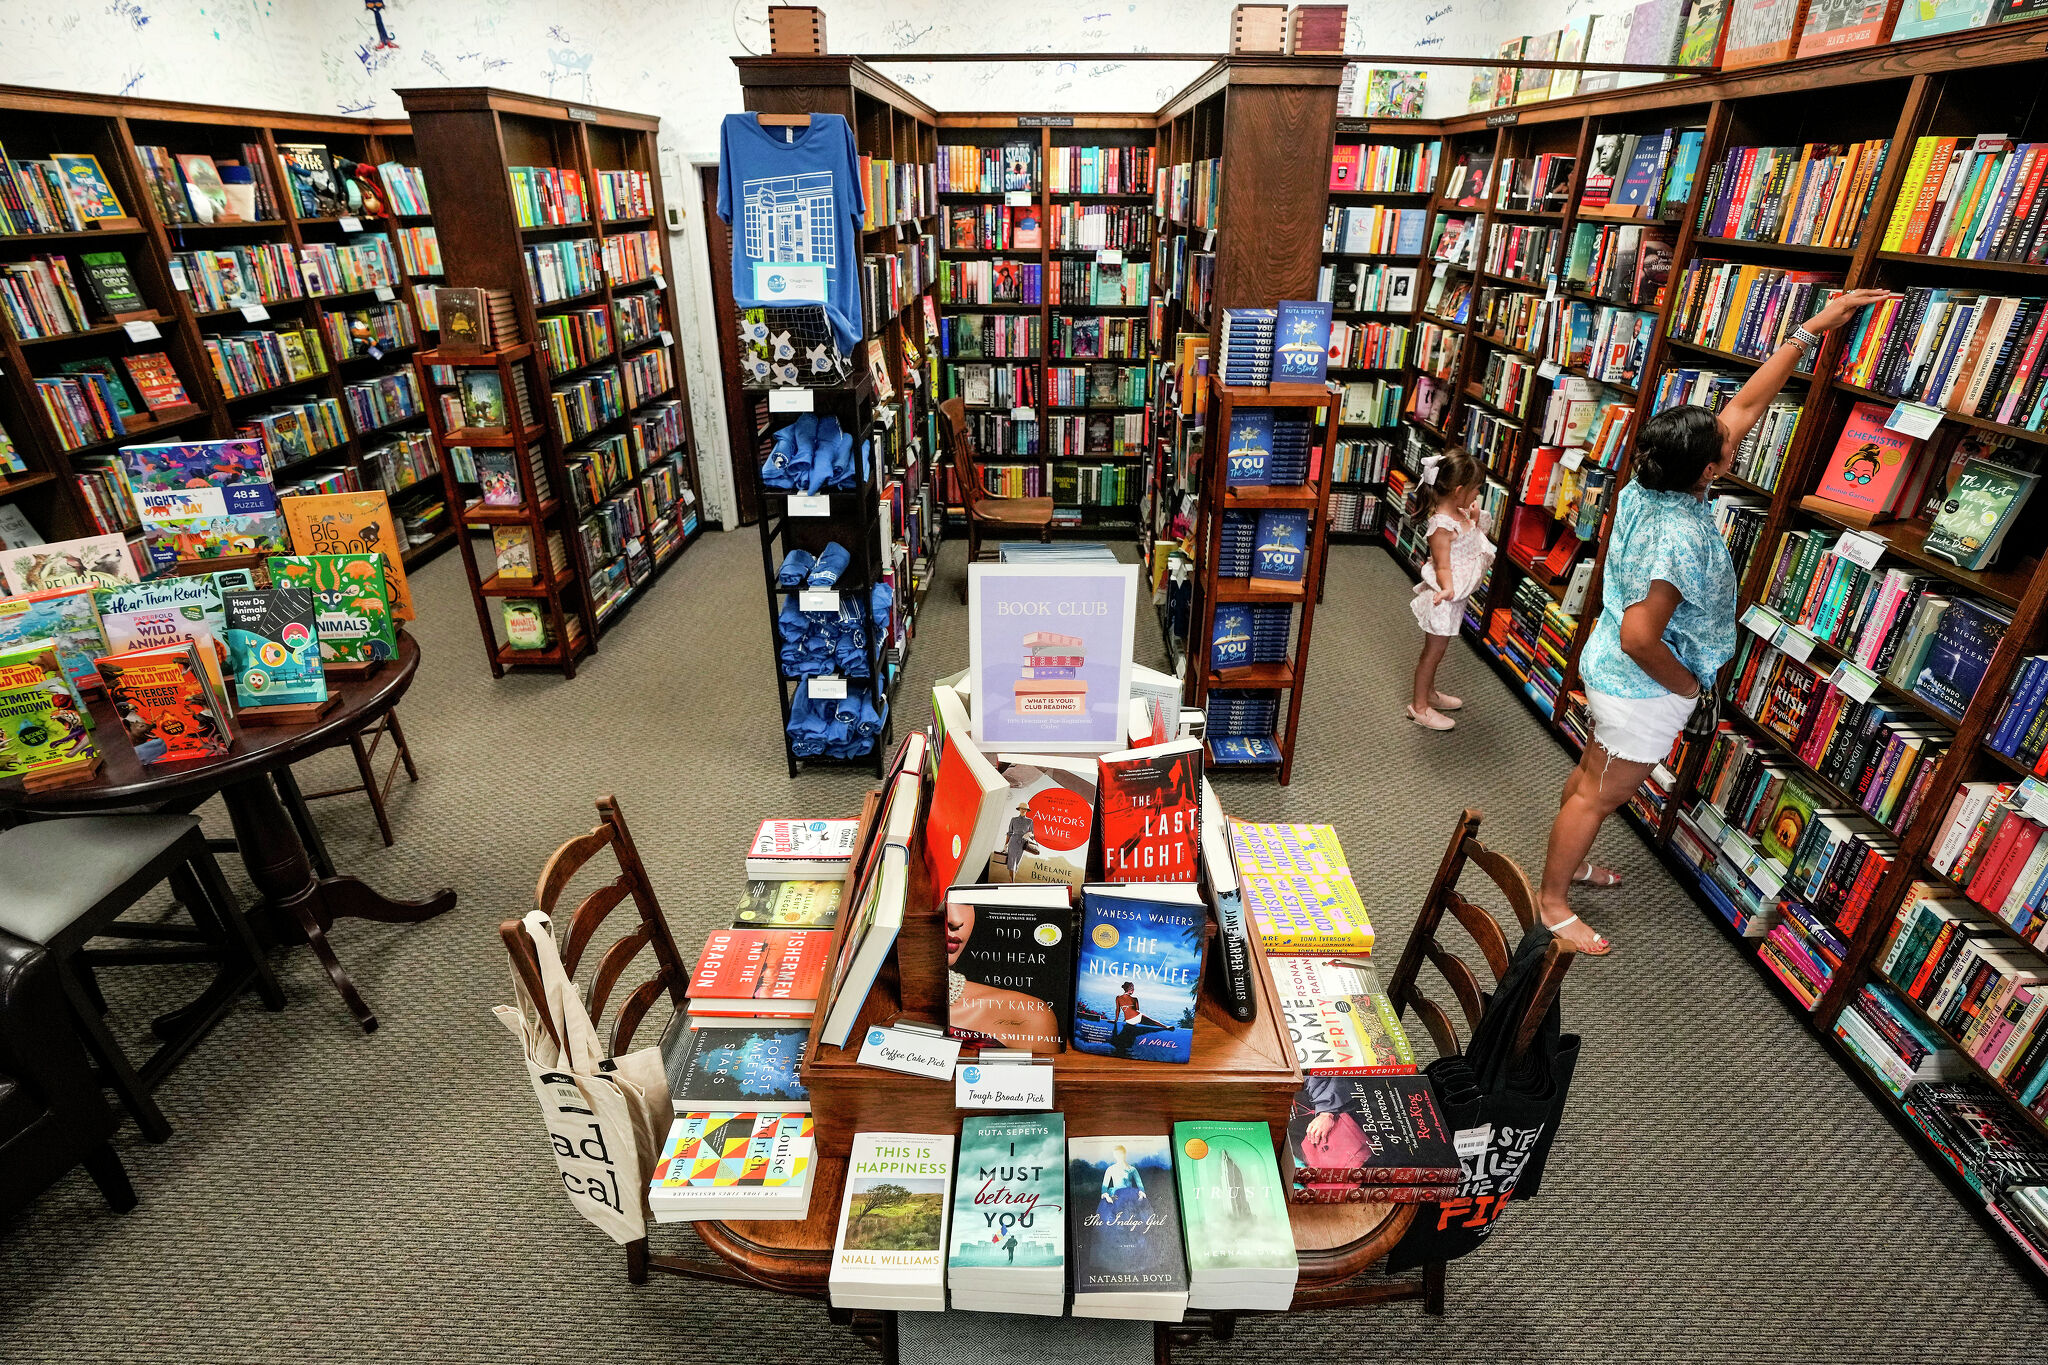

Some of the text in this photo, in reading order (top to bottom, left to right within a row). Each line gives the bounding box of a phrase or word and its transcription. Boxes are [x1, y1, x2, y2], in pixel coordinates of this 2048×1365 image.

[1826, 30, 1871, 46] HAVE POWER
[1922, 143, 1952, 212] WHEN IN ROME
[92, 268, 128, 279] RADIUM
[102, 276, 128, 288] GIRLS
[130, 360, 167, 370] WHO'S
[1284, 354, 1318, 364] YOU
[137, 370, 158, 379] GOT
[1282, 364, 1318, 375] The Story
[141, 377, 174, 388] MAIL?
[1847, 430, 1906, 450] CHEMISTRY
[1976, 430, 2016, 450] HELLO
[1231, 458, 1264, 469] YOU
[233, 490, 248, 499] 48
[1825, 484, 1876, 504] Bonnie Garmus
[1960, 474, 2014, 497] The Last
[144, 494, 177, 507] NIGHT
[182, 503, 203, 515] DAY
[234, 500, 265, 509] PUZZLE
[1961, 489, 1995, 512] Thing
[310, 522, 339, 542] BIG
[1927, 533, 1951, 546] Laura
[110, 584, 210, 614] Hear Them Roar!
[232, 599, 252, 607] How
[996, 601, 1108, 616] BOOK CLUB
[133, 612, 173, 622] PAPERFOLD
[232, 606, 267, 614] Animals
[240, 614, 260, 622] See?
[137, 624, 176, 636] WILD
[316, 620, 368, 632] NIMALS
[1953, 626, 1982, 645] NIGHT
[1938, 632, 1990, 664] TRAVELERS
[120, 668, 183, 687] WOULD WIN?
[1784, 666, 1813, 694] FIRE
[134, 686, 179, 698] FIERCEST
[1921, 680, 1966, 711] LUCAS CORREA
[1930, 678, 1960, 698] ARMANDO
[0, 700, 52, 718] OWDOWN
[147, 696, 176, 708] FEUDS
[1774, 685, 1808, 718] RUSH
[1840, 730, 1853, 755] BOX
[1850, 741, 1864, 770] JUDAS
[1858, 766, 1874, 794] SPIDER
[1132, 795, 1151, 808] THE
[1032, 810, 1086, 828] AVIATOR'S
[1145, 808, 1196, 838] LAST
[774, 822, 792, 853] MURDER
[1044, 824, 1071, 840] WIFE
[1106, 842, 1184, 869] FLIGHT
[1031, 871, 1072, 885] BENJAMIN
[1034, 862, 1072, 878] MELANIE
[1156, 869, 1192, 882] CLARK
[794, 892, 803, 910] KENT
[802, 887, 814, 916] WILLIAM
[825, 888, 840, 916] GRACE
[1254, 878, 1294, 931] IVERSON'S
[1292, 877, 1334, 932] COMMUTING
[1904, 886, 1920, 908] LESS
[1096, 907, 1194, 926] VANESSA WALTERS
[1284, 895, 1311, 926] RULES
[996, 928, 1021, 939] DID
[1797, 912, 1826, 944] LIES TELL
[1128, 936, 1158, 954] THE
[1224, 910, 1244, 971] JANE HARPER
[750, 941, 764, 960] AND
[970, 951, 1046, 964] YOU HEAR
[696, 936, 731, 988] DRAGON
[772, 931, 807, 998] FISHERMEN
[1089, 952, 1190, 984] NIGERWIFE
[740, 962, 758, 983] THE
[983, 975, 1034, 988] ABOUT
[1234, 976, 1246, 1000] EXILES
[962, 998, 1055, 1012] KITTY KARR?
[954, 1030, 1064, 1043] CRYSTAL SMITH PAUL
[1296, 1000, 1334, 1063] NAME
[1316, 999, 1353, 1063] VERITY
[1388, 1016, 1410, 1061] ELIZABETH
[1888, 1024, 1902, 1038] HOUR
[680, 1031, 708, 1097] GLENDY VANDERAH
[714, 1043, 736, 1084] STARS
[742, 1043, 764, 1086] MEETS
[758, 1039, 782, 1090] FOREST
[790, 1040, 808, 1088] WHERE
[880, 1048, 946, 1068] Coffee Cake Pick
[968, 1090, 1046, 1104] Tough Broads Pick
[1408, 1094, 1423, 1118] King
[1350, 1082, 1378, 1132] Bookseller
[1374, 1090, 1394, 1131] Florence
[1924, 1096, 1953, 1129] CONSTANTINE
[978, 1128, 1049, 1136] RUTA SEPETYS
[1416, 1118, 1430, 1140] Ross
[670, 1116, 703, 1184] The Sentence
[750, 1115, 778, 1172] Erdrich
[772, 1125, 798, 1174] Louise
[876, 1146, 930, 1158] THIS IS
[1010, 1142, 1014, 1157] I
[856, 1162, 947, 1174] HAPPINESS
[980, 1166, 1044, 1182] MUST
[974, 1178, 1062, 1222] betray
[1193, 1186, 1272, 1200] TRUST
[984, 1212, 1034, 1228] YOU
[1084, 1212, 1168, 1234] The Indigo Girl
[2008, 1229, 2034, 1257] Catch
[841, 1254, 940, 1265] NIALL WILLIAMS
[1089, 1274, 1172, 1284] NATASHA BOYD
